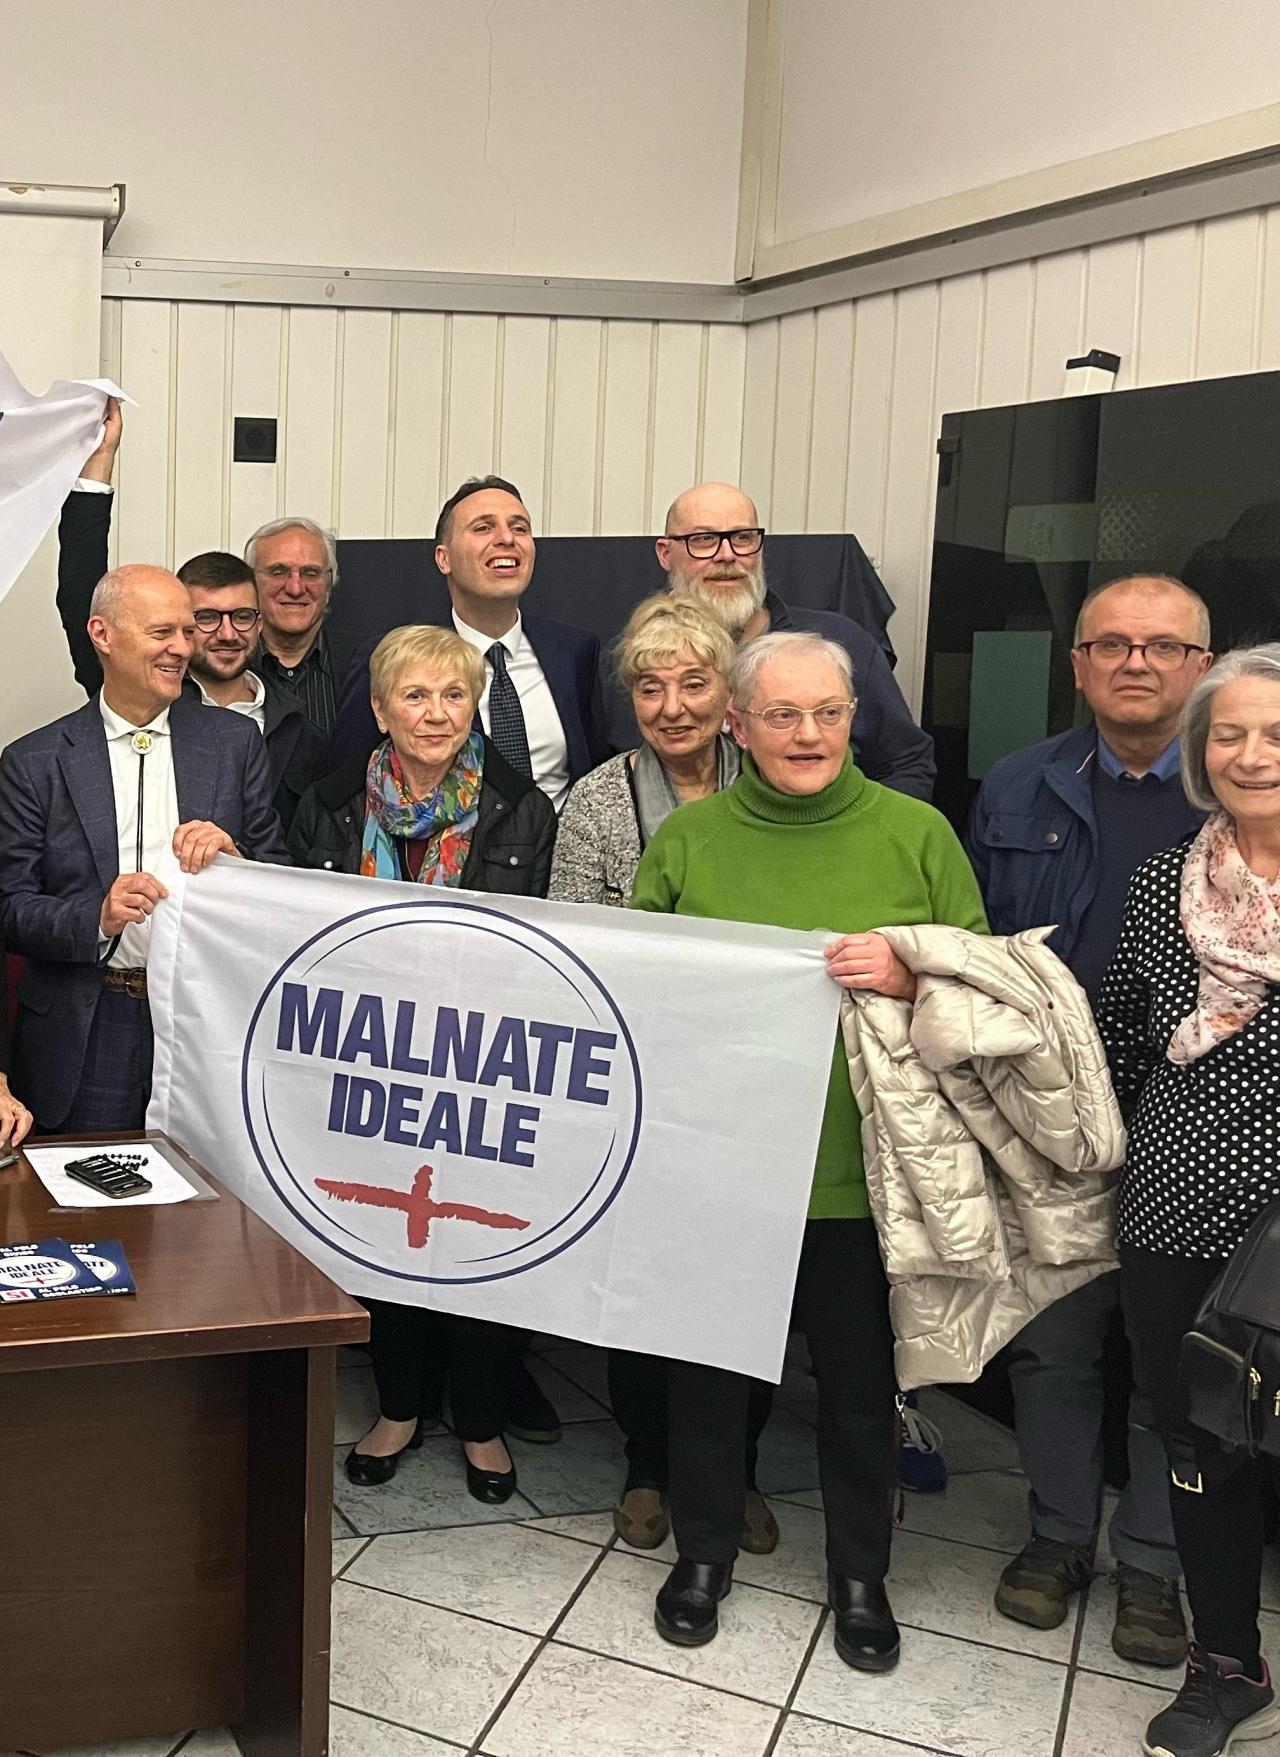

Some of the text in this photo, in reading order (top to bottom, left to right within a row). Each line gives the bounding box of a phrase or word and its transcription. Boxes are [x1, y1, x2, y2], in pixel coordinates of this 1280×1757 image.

[276, 981, 618, 1106] MALNATE
[327, 1073, 540, 1168] IDEALE
[9, 1269, 58, 1279] IDEALE
